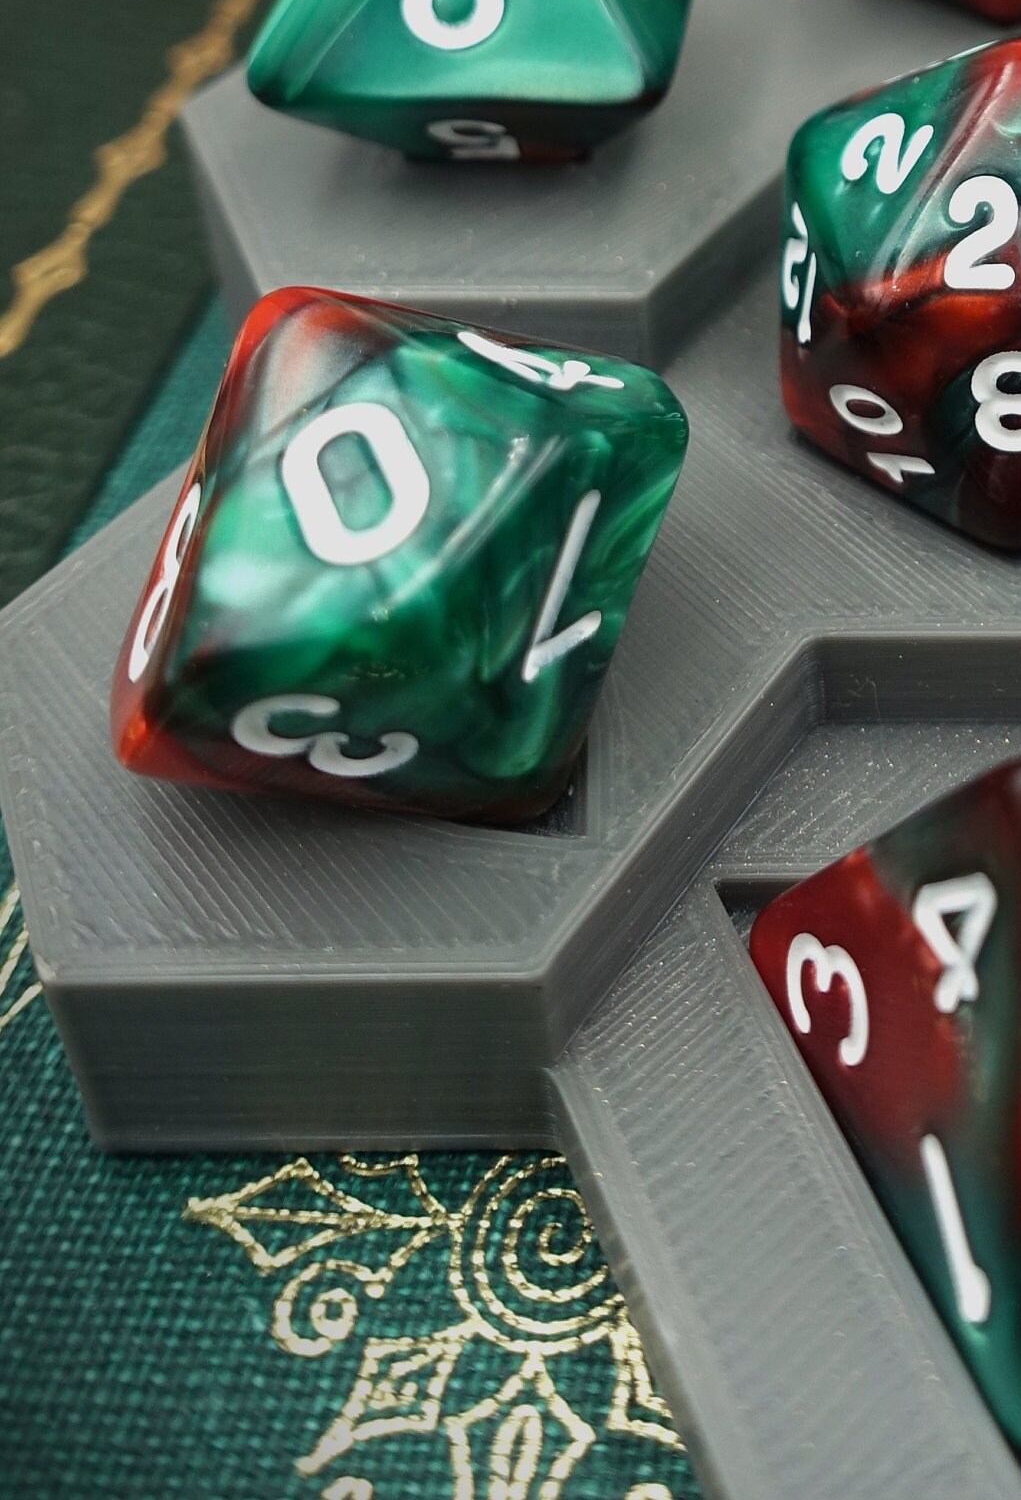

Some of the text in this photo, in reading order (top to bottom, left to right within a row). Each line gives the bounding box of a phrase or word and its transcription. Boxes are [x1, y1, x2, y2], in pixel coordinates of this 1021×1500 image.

[841, 113, 934, 194] 2
[457, 331, 624, 390] 4
[282, 402, 431, 566] 0
[829, 384, 935, 483] 10
[232, 695, 418, 777] 3
[786, 932, 869, 1066] 3
[912, 875, 995, 1013] 4
[920, 1133, 991, 1323] 1
